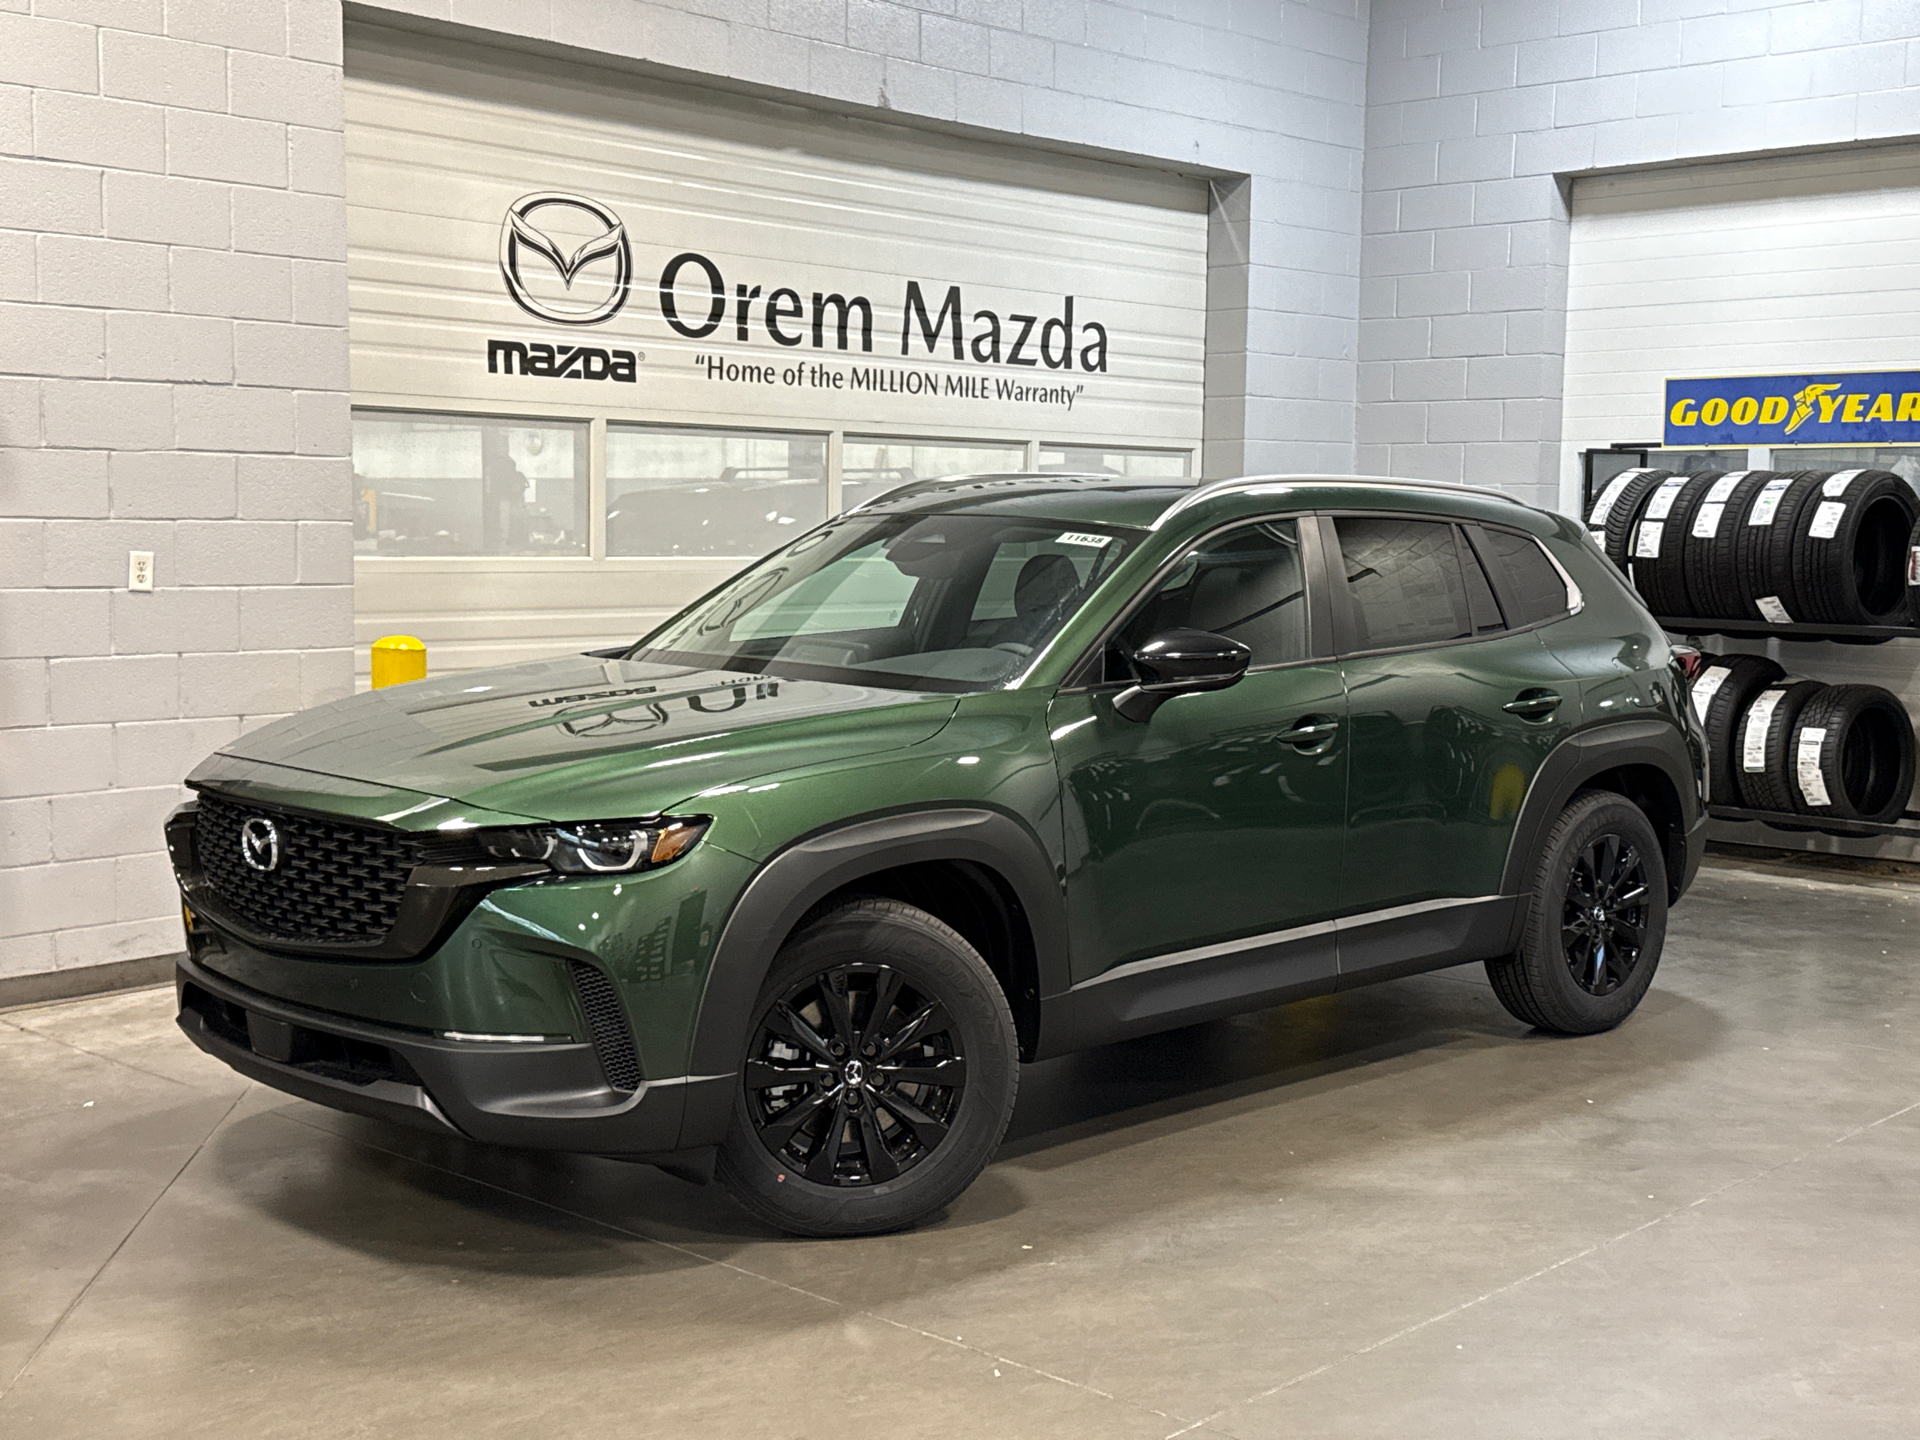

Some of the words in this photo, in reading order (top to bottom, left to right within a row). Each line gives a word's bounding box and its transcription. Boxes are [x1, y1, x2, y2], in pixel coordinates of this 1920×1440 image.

[659, 252, 873, 352] Orem
[901, 280, 1108, 373] Mazda
[487, 339, 637, 383] mazda
[695, 354, 776, 384] “Home
[783, 361, 806, 386] of
[810, 363, 844, 389] the
[850, 367, 939, 396] MILLION
[944, 374, 990, 399] MILE
